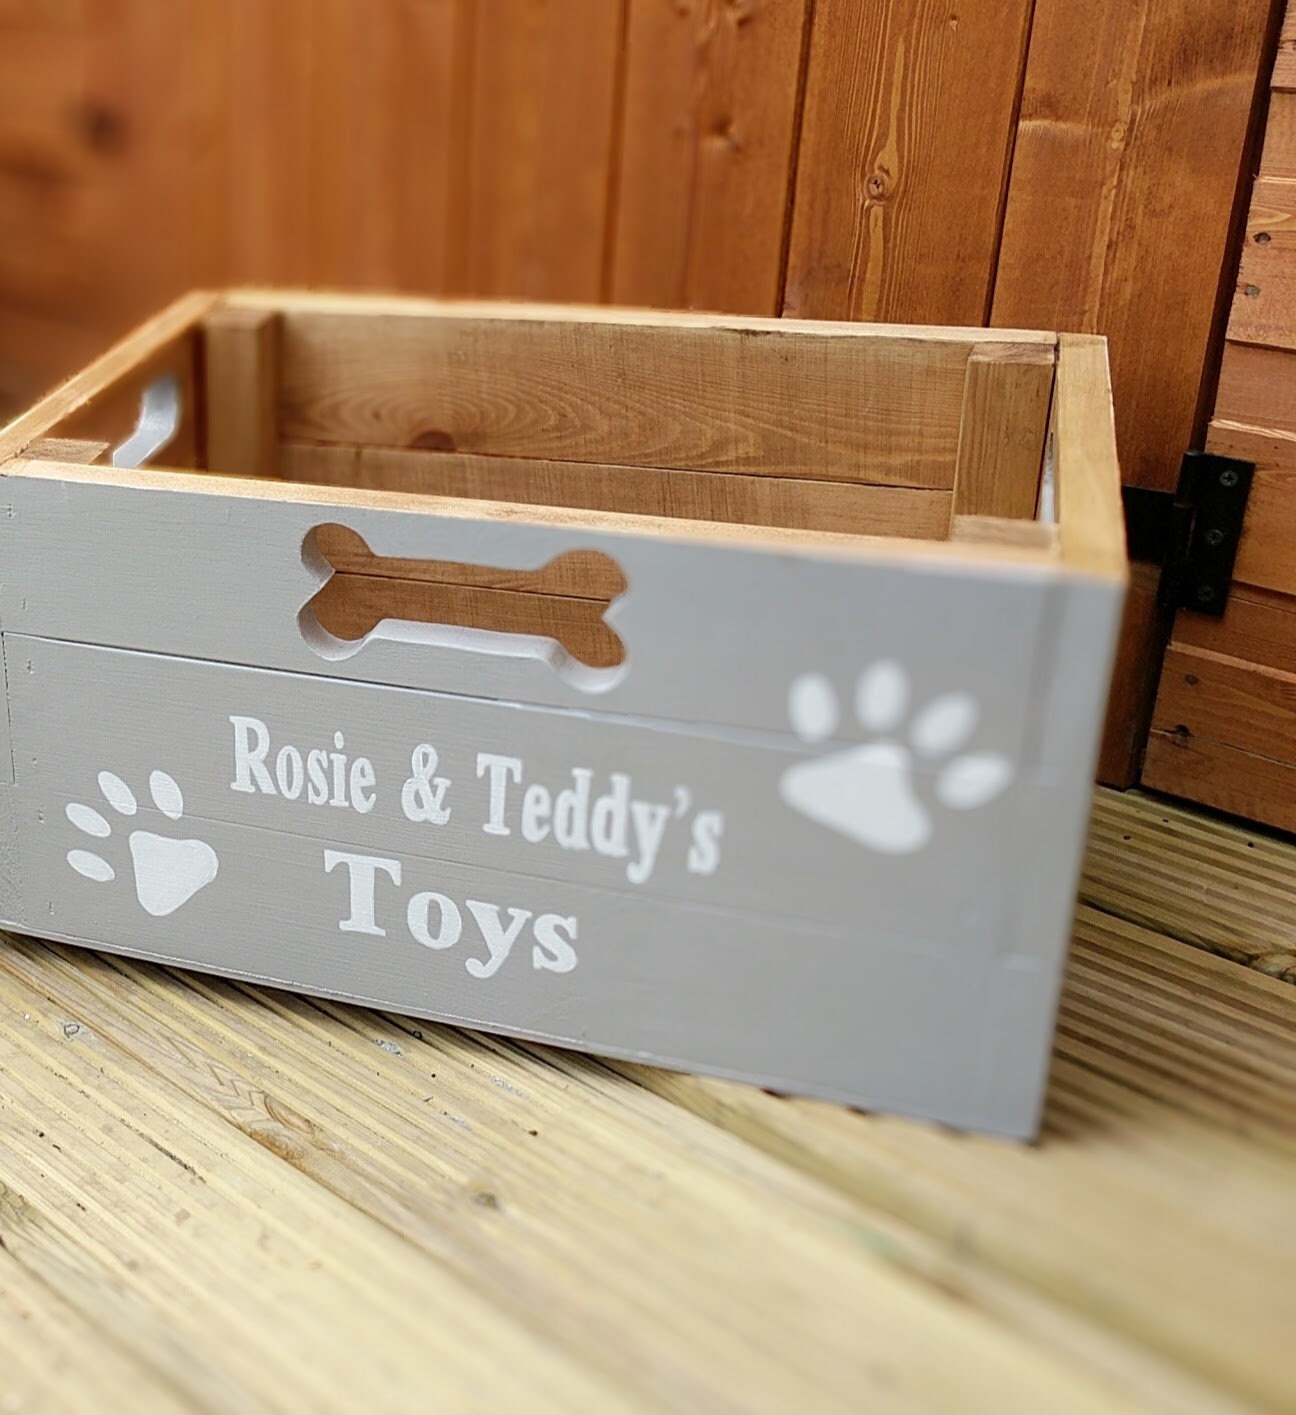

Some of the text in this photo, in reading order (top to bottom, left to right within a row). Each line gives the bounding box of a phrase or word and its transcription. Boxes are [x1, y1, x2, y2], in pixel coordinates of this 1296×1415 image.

[228, 715, 724, 884] Rosie & Teddy's
[323, 849, 579, 979] Toys
